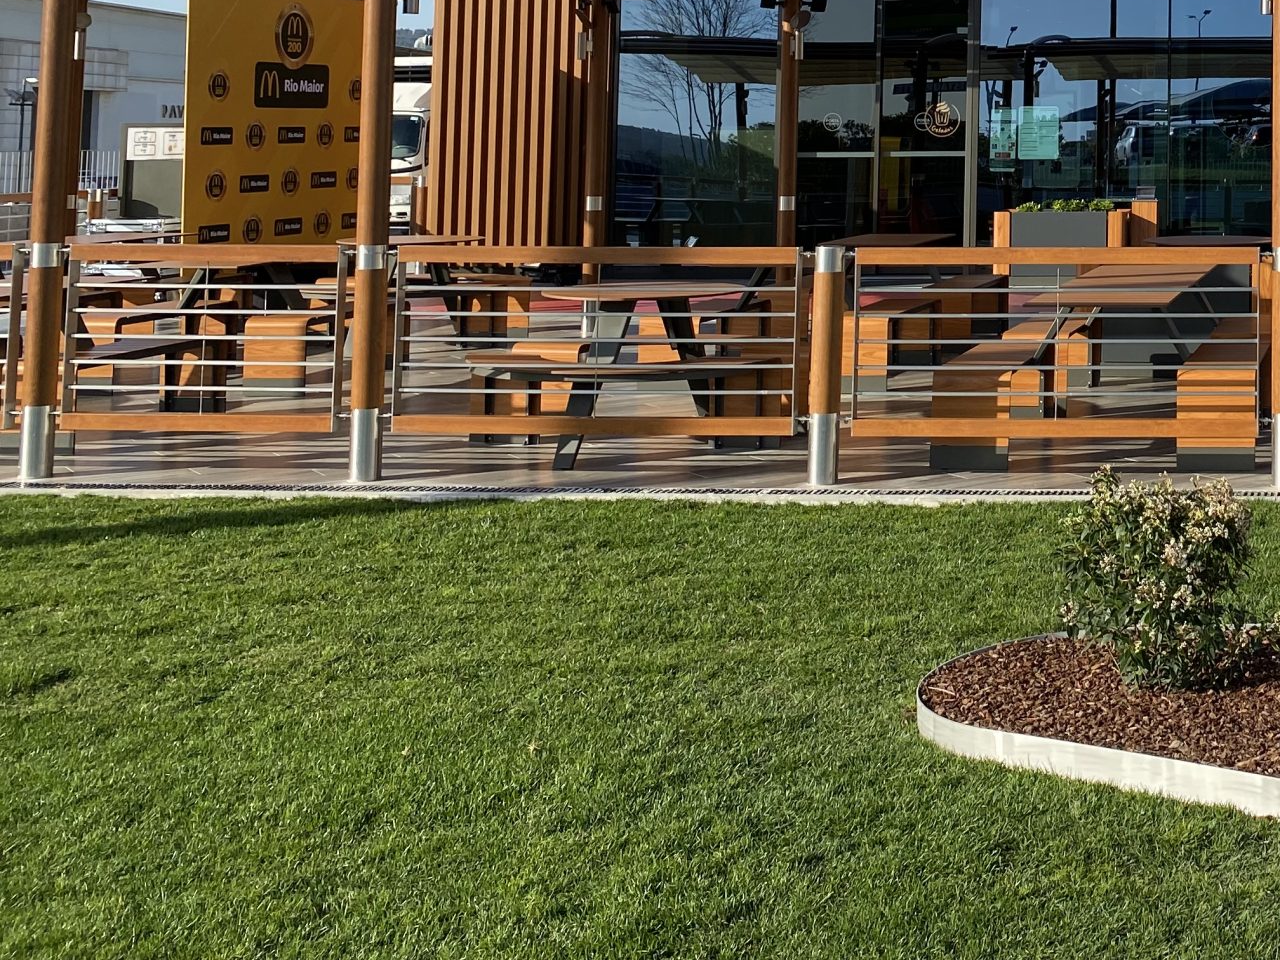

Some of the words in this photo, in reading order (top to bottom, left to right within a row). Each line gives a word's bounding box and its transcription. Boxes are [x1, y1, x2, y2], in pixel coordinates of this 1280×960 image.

[287, 41, 302, 53] 200
[284, 78, 299, 92] Rio
[299, 79, 325, 93] Maior
